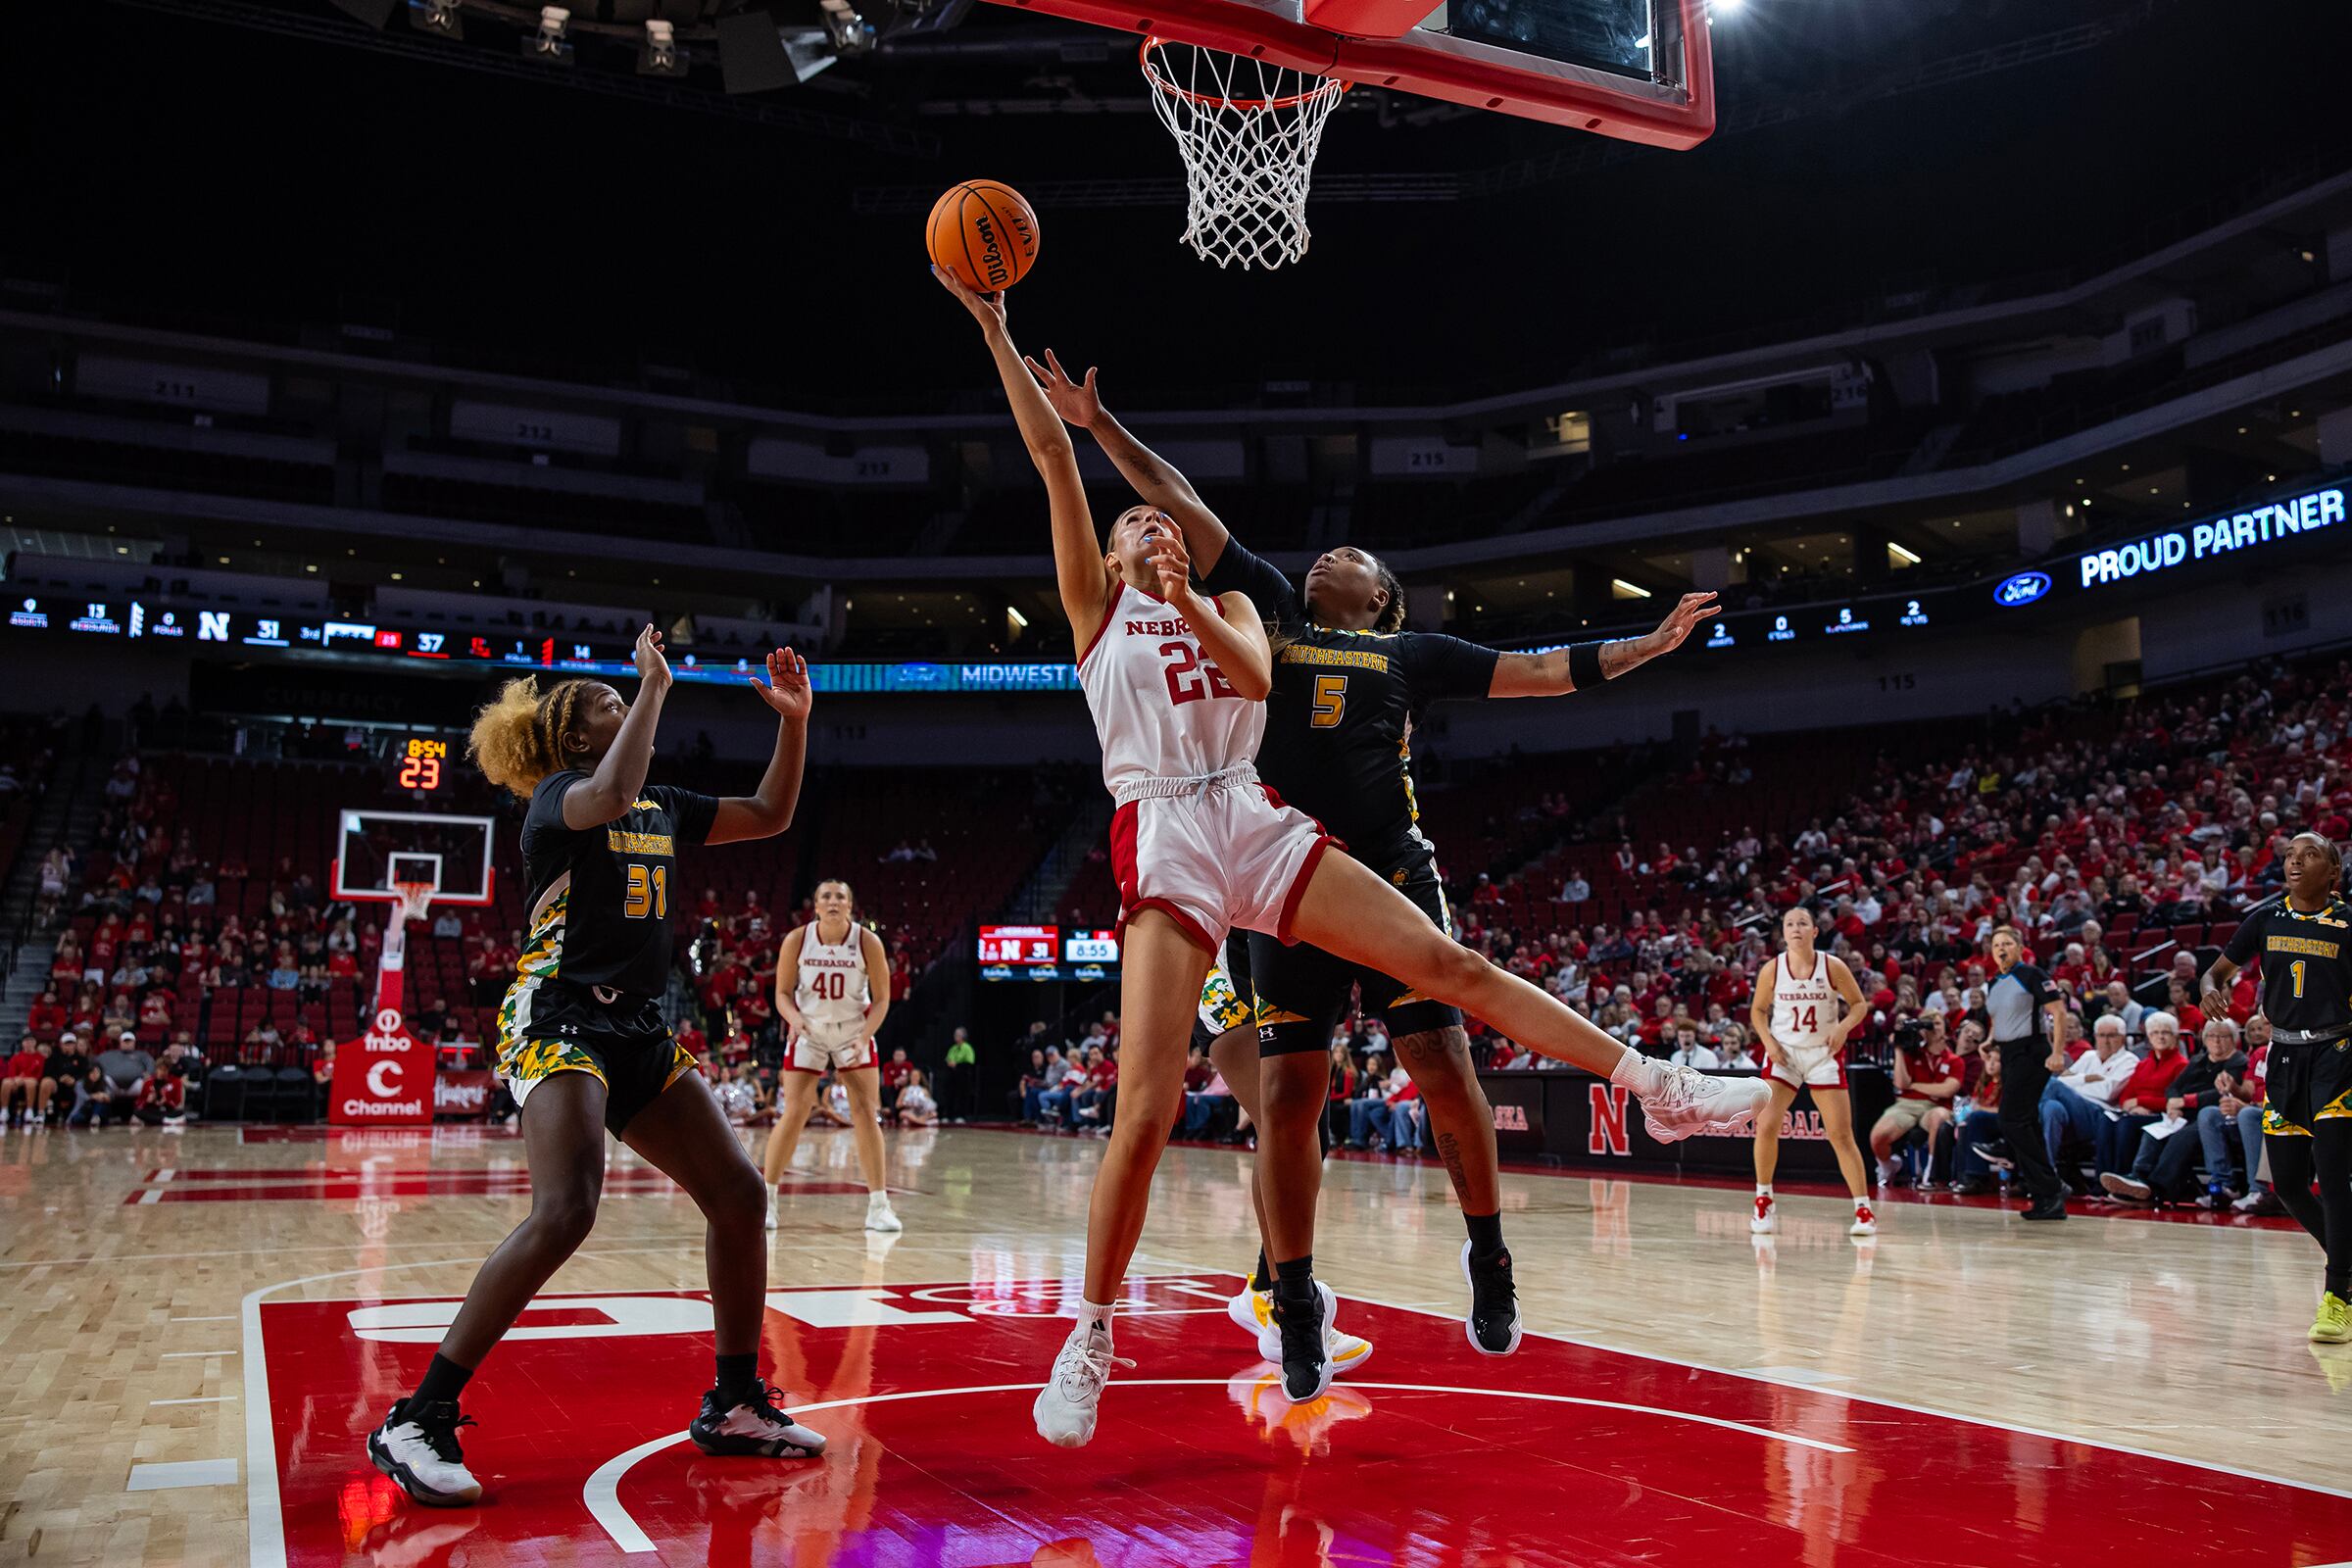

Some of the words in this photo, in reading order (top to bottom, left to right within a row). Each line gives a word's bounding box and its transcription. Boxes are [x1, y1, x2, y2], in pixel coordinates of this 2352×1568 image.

[975, 215, 1009, 287] Wilson
[1412, 453, 1444, 466] 215
[2081, 532, 2186, 588] PROUD
[2192, 489, 2346, 560] PARTNER
[2004, 578, 2040, 603] Ford
[87, 603, 106, 618] 13
[1839, 609, 1852, 624] 5
[1908, 601, 1920, 616] 2
[198, 611, 230, 642] N
[257, 619, 279, 639] 31
[1125, 617, 1193, 636] NEBR
[1715, 623, 1726, 637] 2
[1776, 616, 1788, 630] 0
[417, 632, 445, 654] 37
[1281, 643, 1389, 674] SOUTHEASTERN
[962, 666, 1066, 682] MIDWEST
[1879, 673, 1915, 692] 115
[1310, 674, 1348, 728] 5
[409, 739, 446, 758] 8:54
[400, 758, 439, 789] 23
[624, 864, 666, 919] 31
[1076, 945, 1107, 957] 8:55
[804, 958, 856, 968] NEBRASKA
[811, 971, 845, 1001] 40
[2290, 959, 2306, 999] 1
[1791, 1004, 1818, 1033] 14
[364, 1032, 412, 1052] fnbo
[344, 1099, 421, 1115] Channel
[1589, 1083, 1631, 1156] N
